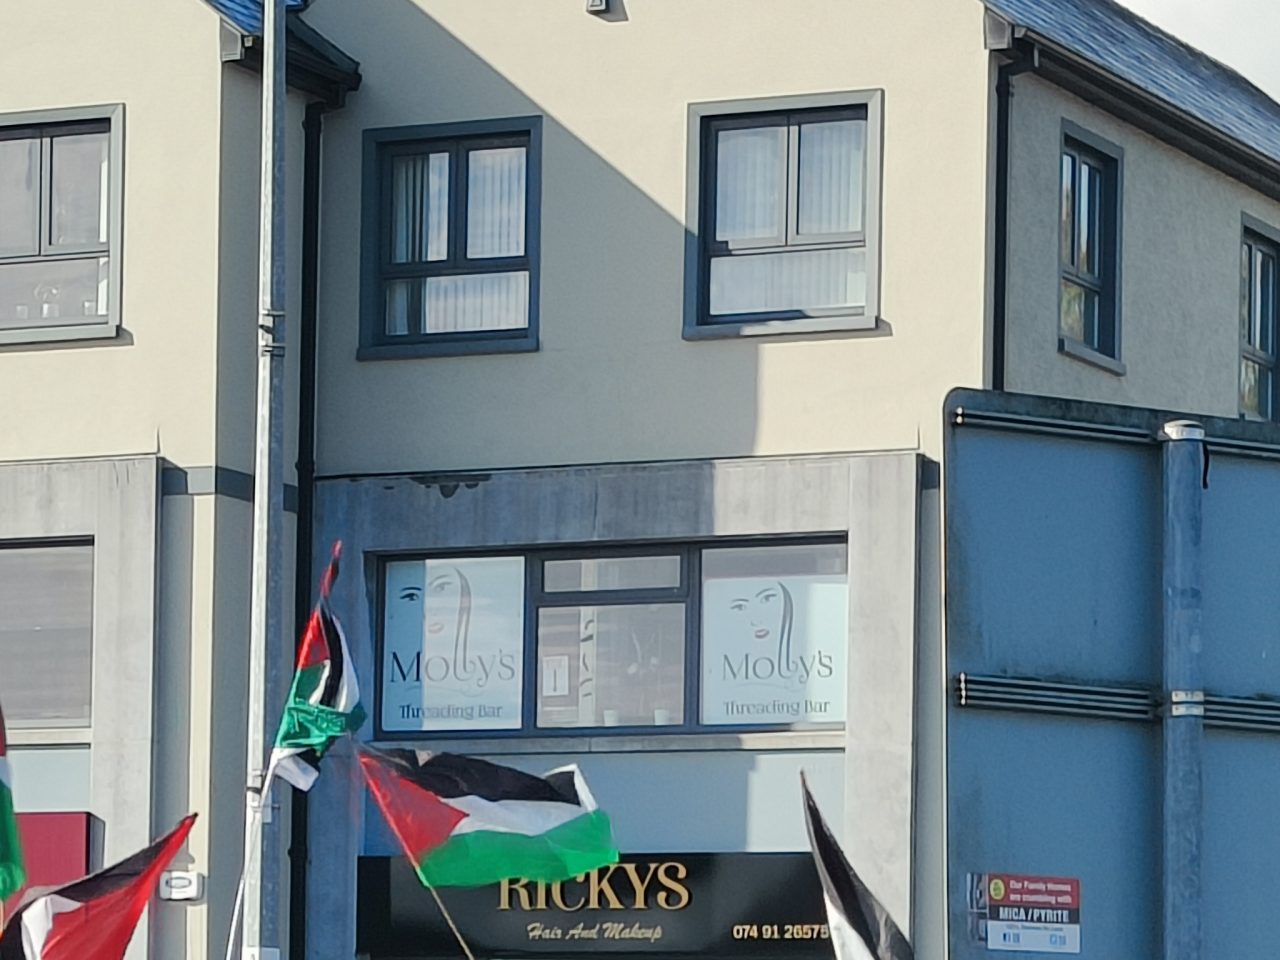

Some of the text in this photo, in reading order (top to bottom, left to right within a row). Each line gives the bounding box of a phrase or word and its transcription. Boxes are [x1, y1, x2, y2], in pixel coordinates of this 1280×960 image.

[399, 703, 503, 720] Threading Bar
[724, 699, 830, 716] Threading Bar
[497, 862, 691, 912] RICKYS
[527, 921, 663, 943] Hair And Makeup
[732, 924, 759, 939] 074
[762, 924, 781, 939] 91
